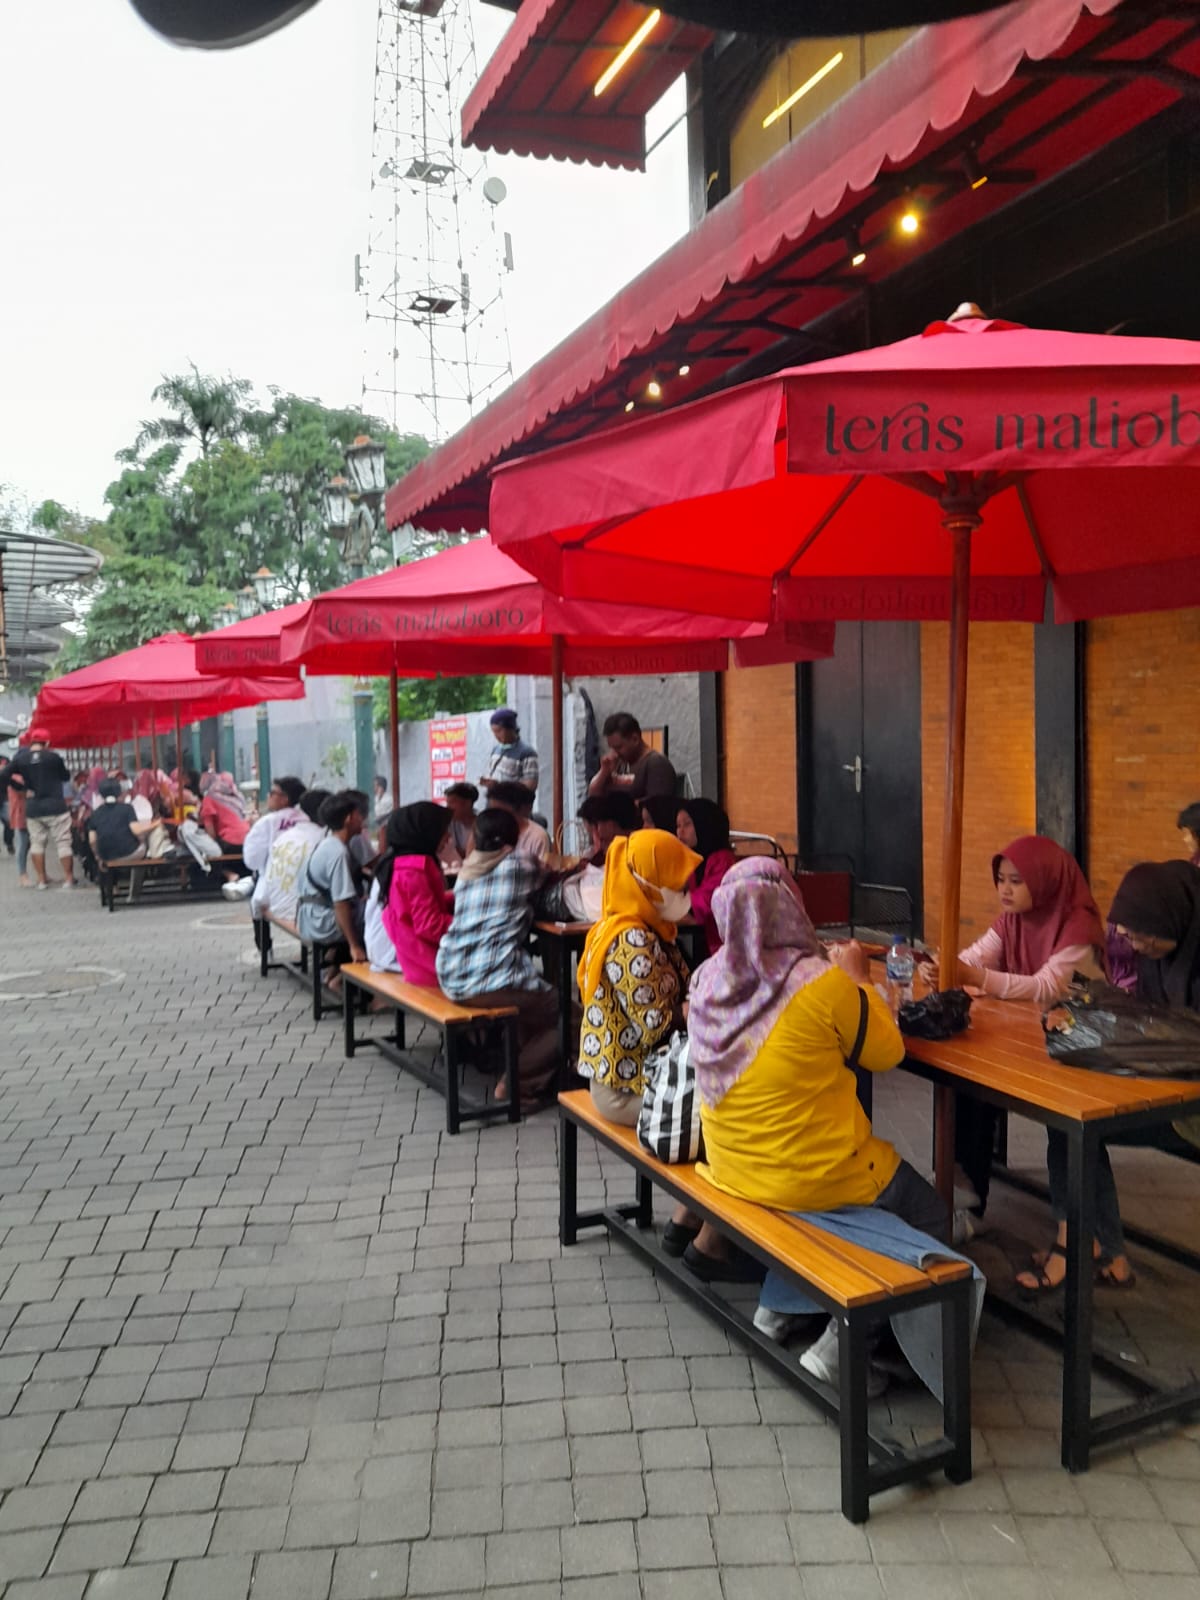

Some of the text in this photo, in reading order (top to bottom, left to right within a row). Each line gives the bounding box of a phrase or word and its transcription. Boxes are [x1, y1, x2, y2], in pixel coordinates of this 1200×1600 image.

[824, 402, 964, 455] teras
[327, 604, 525, 636] teras malioboro
